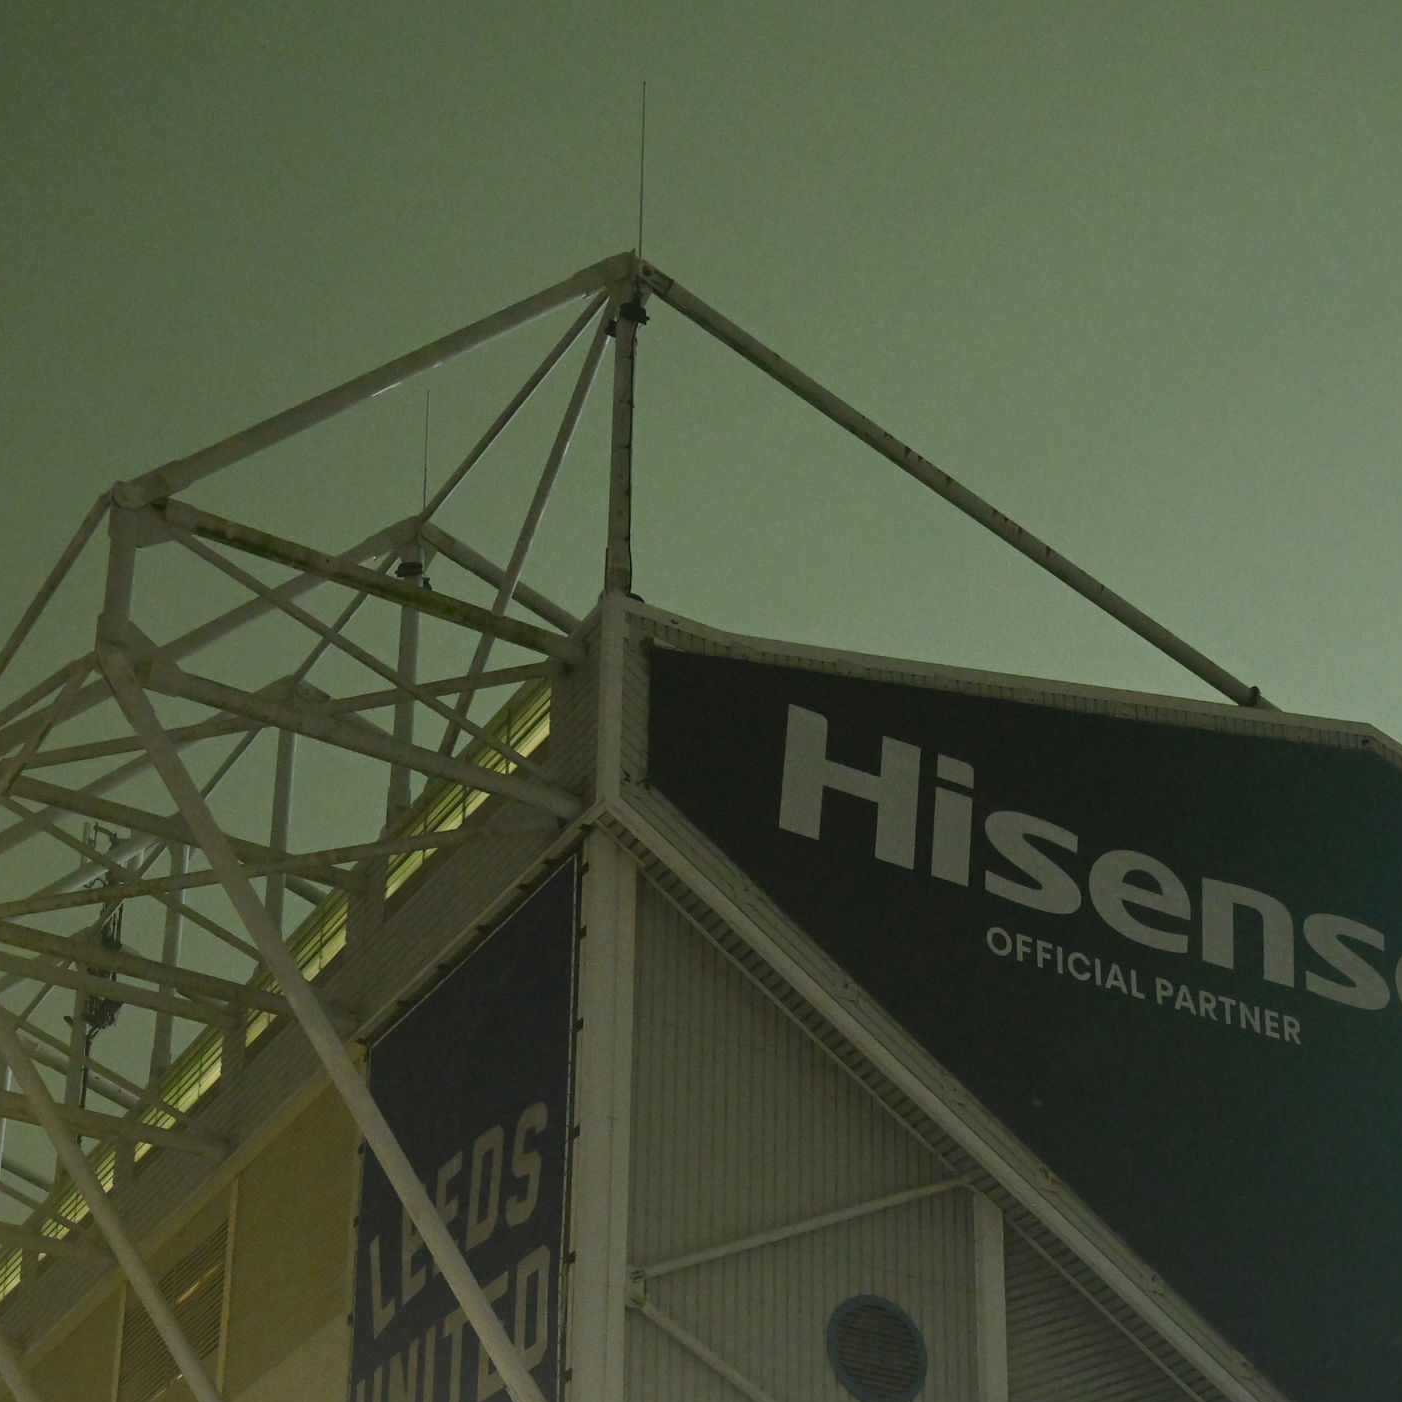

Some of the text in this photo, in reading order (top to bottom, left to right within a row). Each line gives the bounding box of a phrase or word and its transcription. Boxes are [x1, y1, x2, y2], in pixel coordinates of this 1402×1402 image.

[986, 925, 1303, 1045] OFFICIAL PARTNER
[369, 1101, 549, 1340] LEEDS
